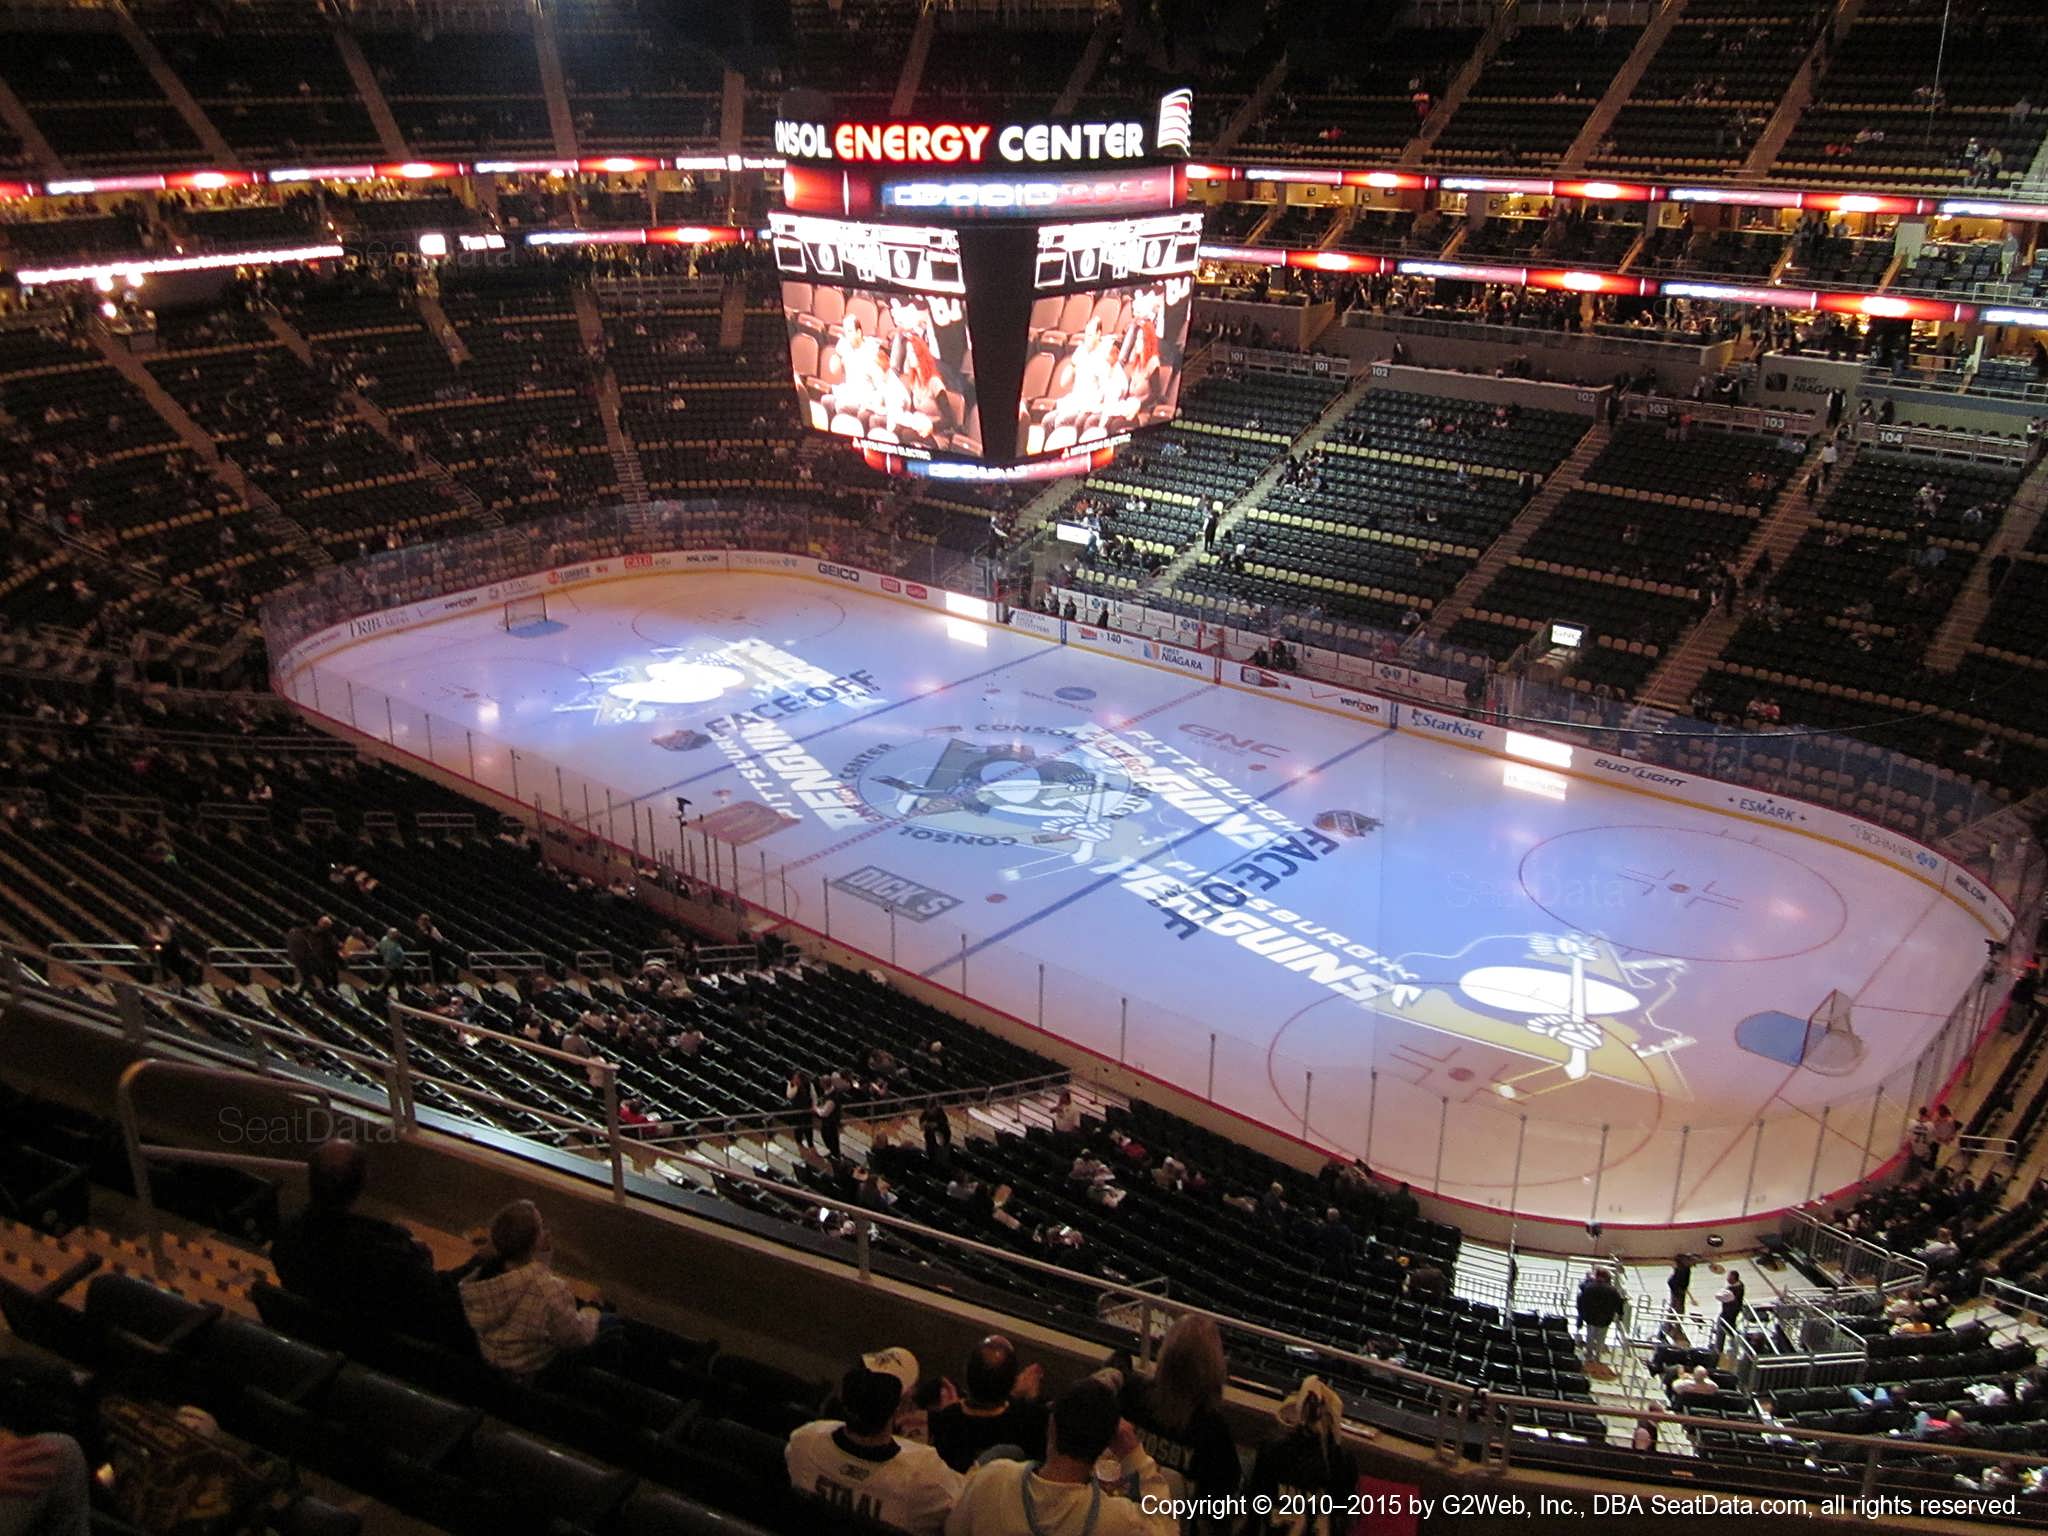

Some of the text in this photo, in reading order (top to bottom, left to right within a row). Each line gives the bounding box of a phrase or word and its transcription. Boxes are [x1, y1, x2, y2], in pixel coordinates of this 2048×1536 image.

[836, 124, 990, 161] ENERGY
[999, 122, 1144, 161] CENTER
[1315, 361, 1329, 372] 101
[1372, 366, 1389, 378] 102
[1764, 416, 1786, 429] 103
[1880, 431, 1904, 444] 104
[818, 562, 860, 583] GEICO
[1106, 632, 1122, 645] 140
[1161, 652, 1203, 671] NIAGARA
[1340, 696, 1379, 714] verizon
[975, 723, 1079, 740] CONSOL
[1421, 713, 1484, 740] StarKist
[1178, 723, 1292, 758] GNC
[1593, 758, 1688, 788] BUD LIGHT
[1739, 798, 1796, 822] ESMARK
[900, 825, 1018, 846] CONSOL
